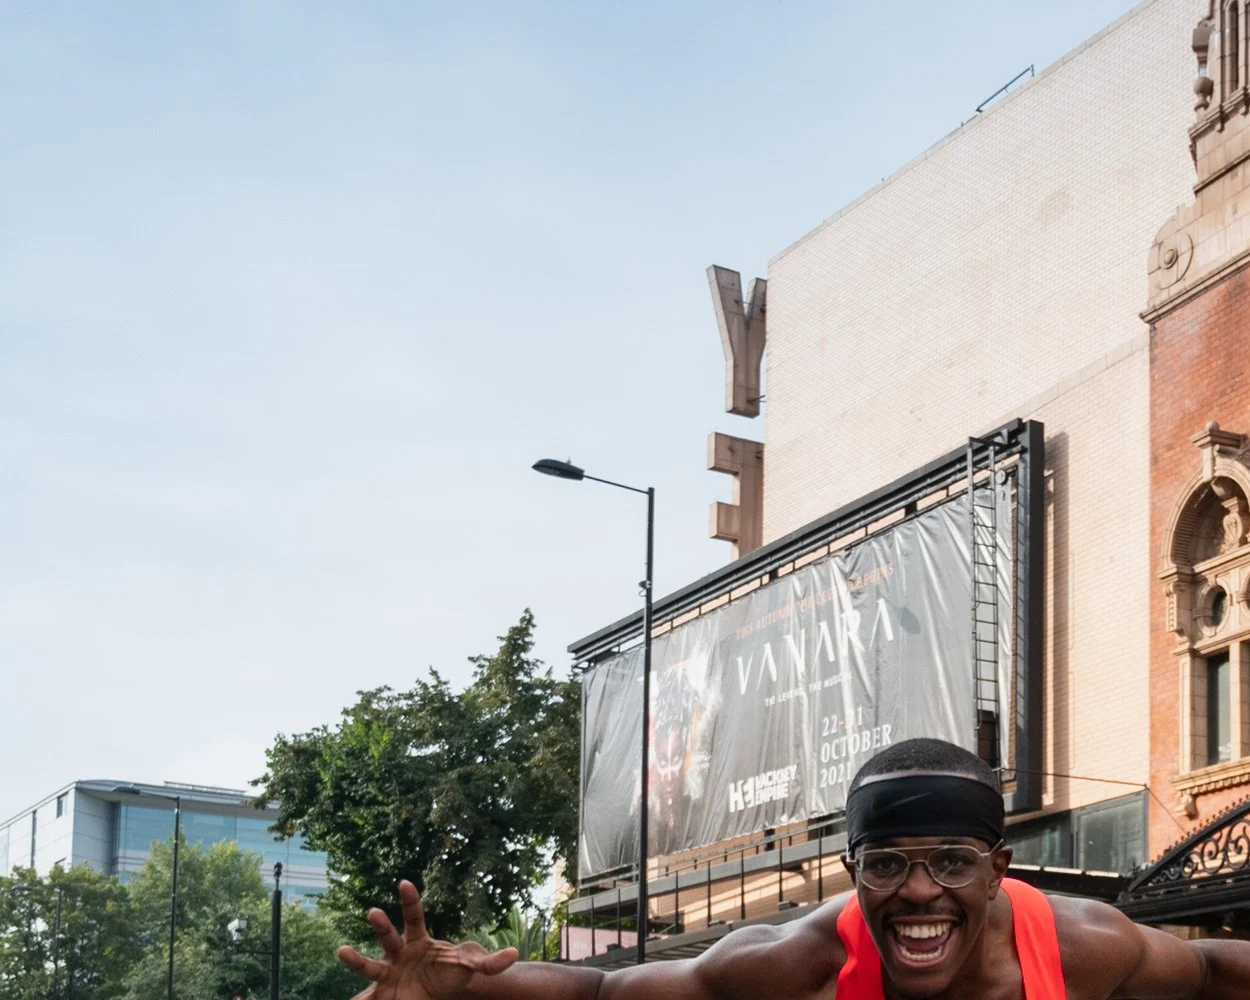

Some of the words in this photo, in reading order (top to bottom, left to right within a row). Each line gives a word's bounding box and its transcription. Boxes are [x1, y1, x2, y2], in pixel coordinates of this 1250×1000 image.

[736, 597, 894, 696] VANARA
[820, 724, 892, 763] OCTOBER
[755, 765, 797, 789] HACKNEY
[820, 762, 853, 788] 2021
[755, 783, 789, 806] EMPIRE
